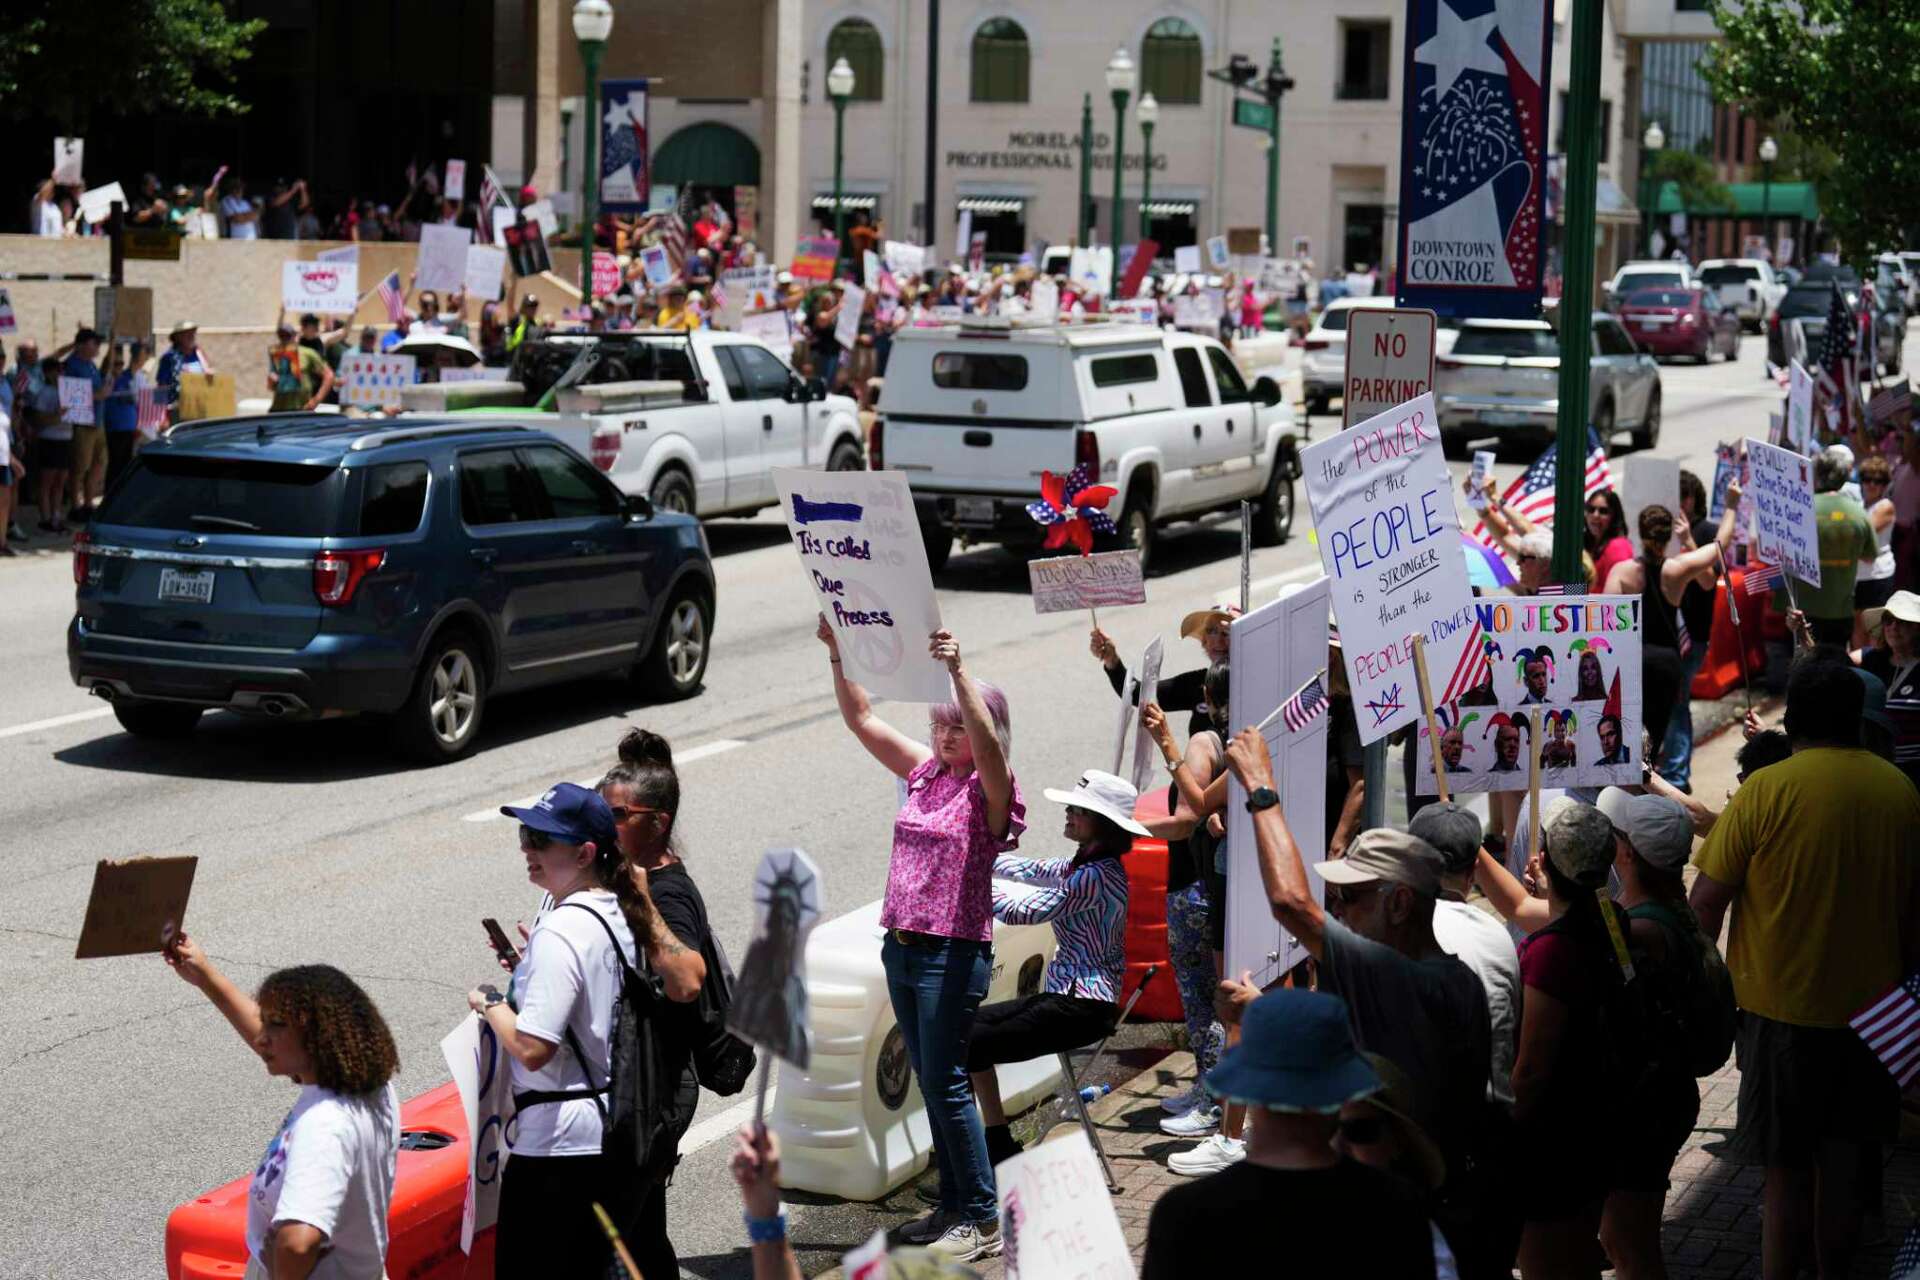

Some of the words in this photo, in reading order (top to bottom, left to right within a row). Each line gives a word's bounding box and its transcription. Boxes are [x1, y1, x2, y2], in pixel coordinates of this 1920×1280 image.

[946, 151, 1072, 169] PROFESSIONAL
[1086, 153, 1168, 170] UILDIG
[1412, 239, 1496, 258] DOWNTOWN
[1411, 258, 1496, 283] CONROE
[1375, 333, 1407, 358] NO
[1321, 456, 1346, 483] the
[1353, 411, 1433, 470] POWER
[1364, 479, 1379, 503] of
[1384, 473, 1409, 493] the
[825, 536, 872, 561] called
[1331, 489, 1443, 579] PEOPLE
[1084, 558, 1134, 581] People
[1353, 589, 1365, 604] is
[1378, 547, 1440, 593] STRONGER
[832, 600, 895, 628] Process
[1378, 604, 1407, 626] than
[1412, 589, 1433, 609] the
[1475, 603, 1513, 633] NO
[1521, 599, 1640, 633] JESTERS!
[1354, 633, 1414, 686] PEOPLE
[1431, 605, 1473, 643] POWER
[1022, 1159, 1098, 1216] DEFEN
[1041, 1216, 1095, 1266] THE
